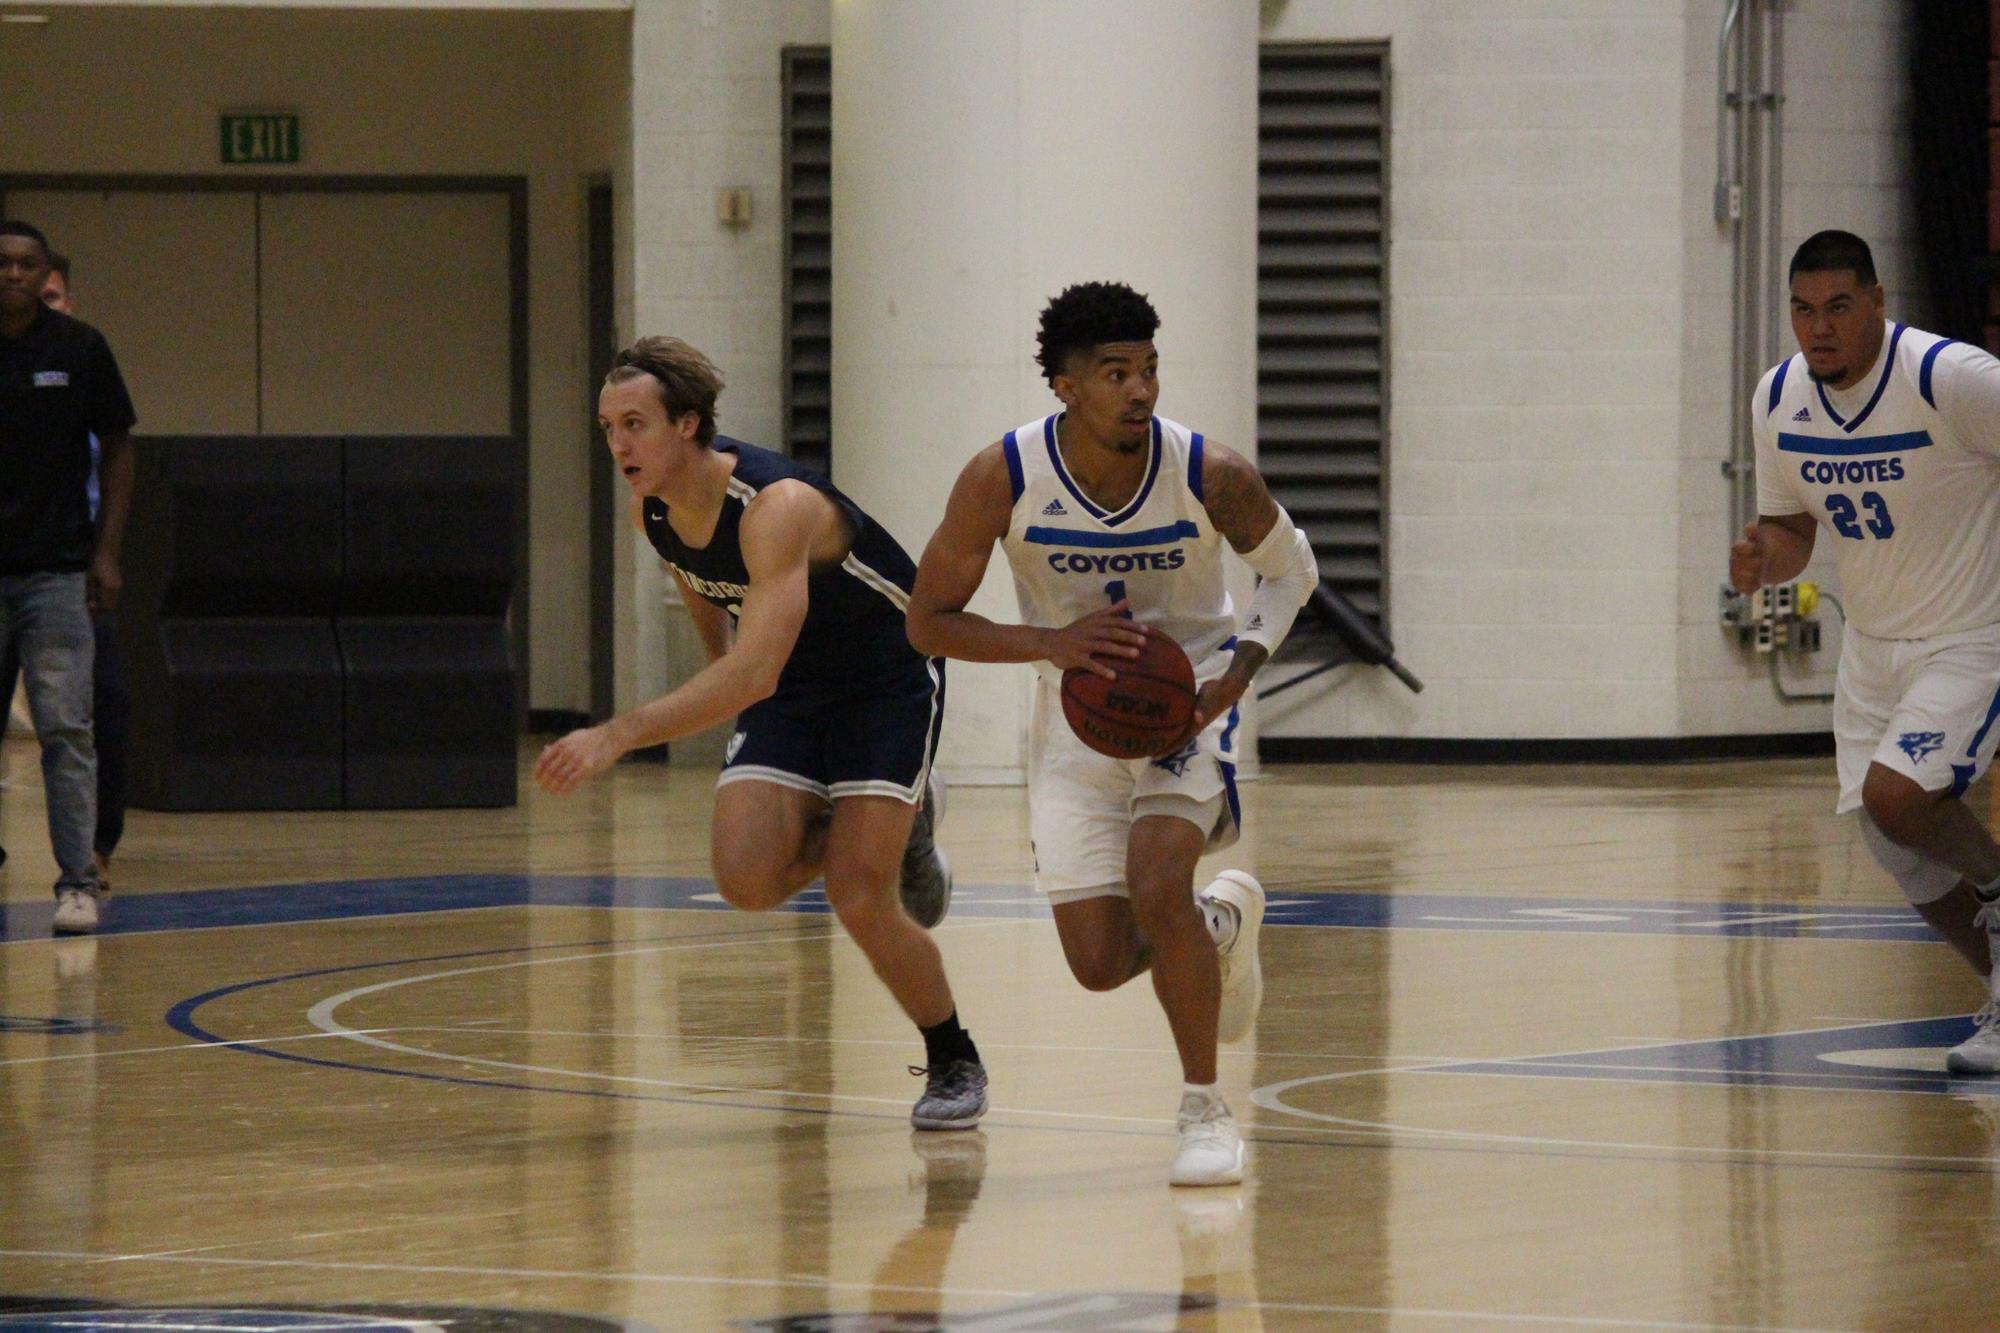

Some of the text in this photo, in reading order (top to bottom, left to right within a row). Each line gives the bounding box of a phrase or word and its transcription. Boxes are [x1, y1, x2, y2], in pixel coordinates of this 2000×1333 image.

[231, 119, 290, 159] EXIT
[1800, 457, 1905, 484] COYOTES
[1824, 491, 1895, 540] 23
[1047, 548, 1186, 574] COYOTES
